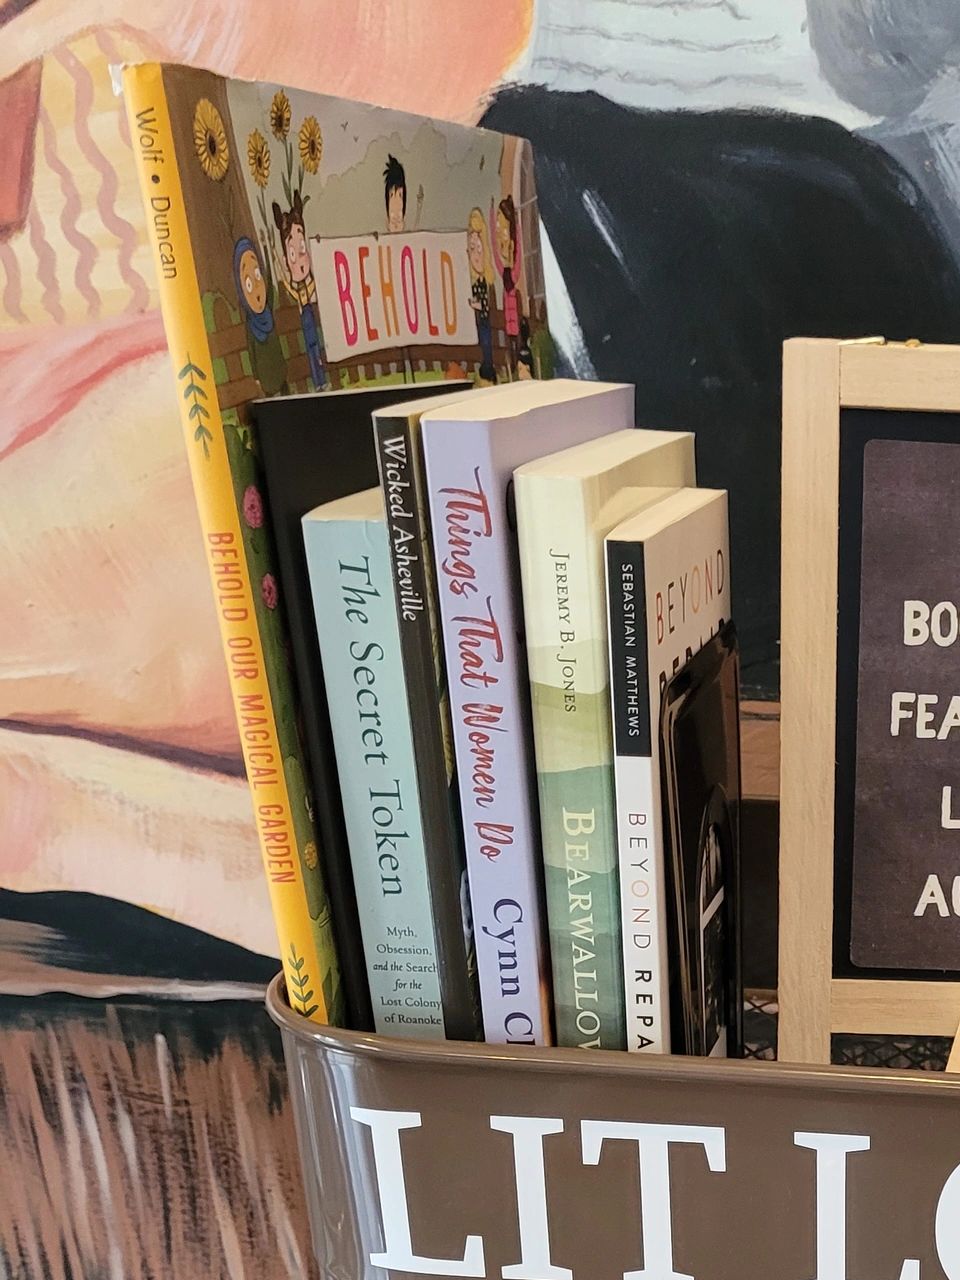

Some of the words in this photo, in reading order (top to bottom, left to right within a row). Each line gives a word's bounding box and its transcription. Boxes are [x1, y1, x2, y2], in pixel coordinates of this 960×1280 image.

[135, 107, 165, 166] Wolf
[147, 196, 182, 281] Duncan
[333, 245, 459, 347] BEHOLD
[382, 434, 414, 519] Wicked
[393, 523, 424, 622] Asheville
[437, 465, 492, 600] Things
[207, 531, 249, 622] BEHOLD
[338, 555, 381, 625] The
[549, 548, 572, 625] JEREMY
[620, 563, 637, 648] SEBASTIAN
[656, 549, 725, 646] BEYOND
[227, 636, 259, 681] OUR
[450, 595, 504, 690] That
[556, 651, 577, 713] JONES
[559, 629, 576, 650] B.
[349, 641, 390, 765] Secret
[625, 655, 641, 738] MATTHEWS
[237, 693, 279, 790] MAGICAL
[461, 702, 509, 809] Women
[258, 803, 296, 884] GARDEN
[368, 779, 410, 897] Token
[473, 821, 514, 864] Do
[628, 812, 652, 950] BEYOND
[372, 962, 389, 972] and
[390, 962, 403, 972] the
[392, 979, 408, 991] for
[409, 980, 423, 990] the
[481, 897, 523, 998] Cynn
[380, 995, 403, 1007] Lost
[405, 996, 442, 1009] Colony
[384, 1013, 397, 1024] of
[398, 1014, 442, 1025] Roanoke
